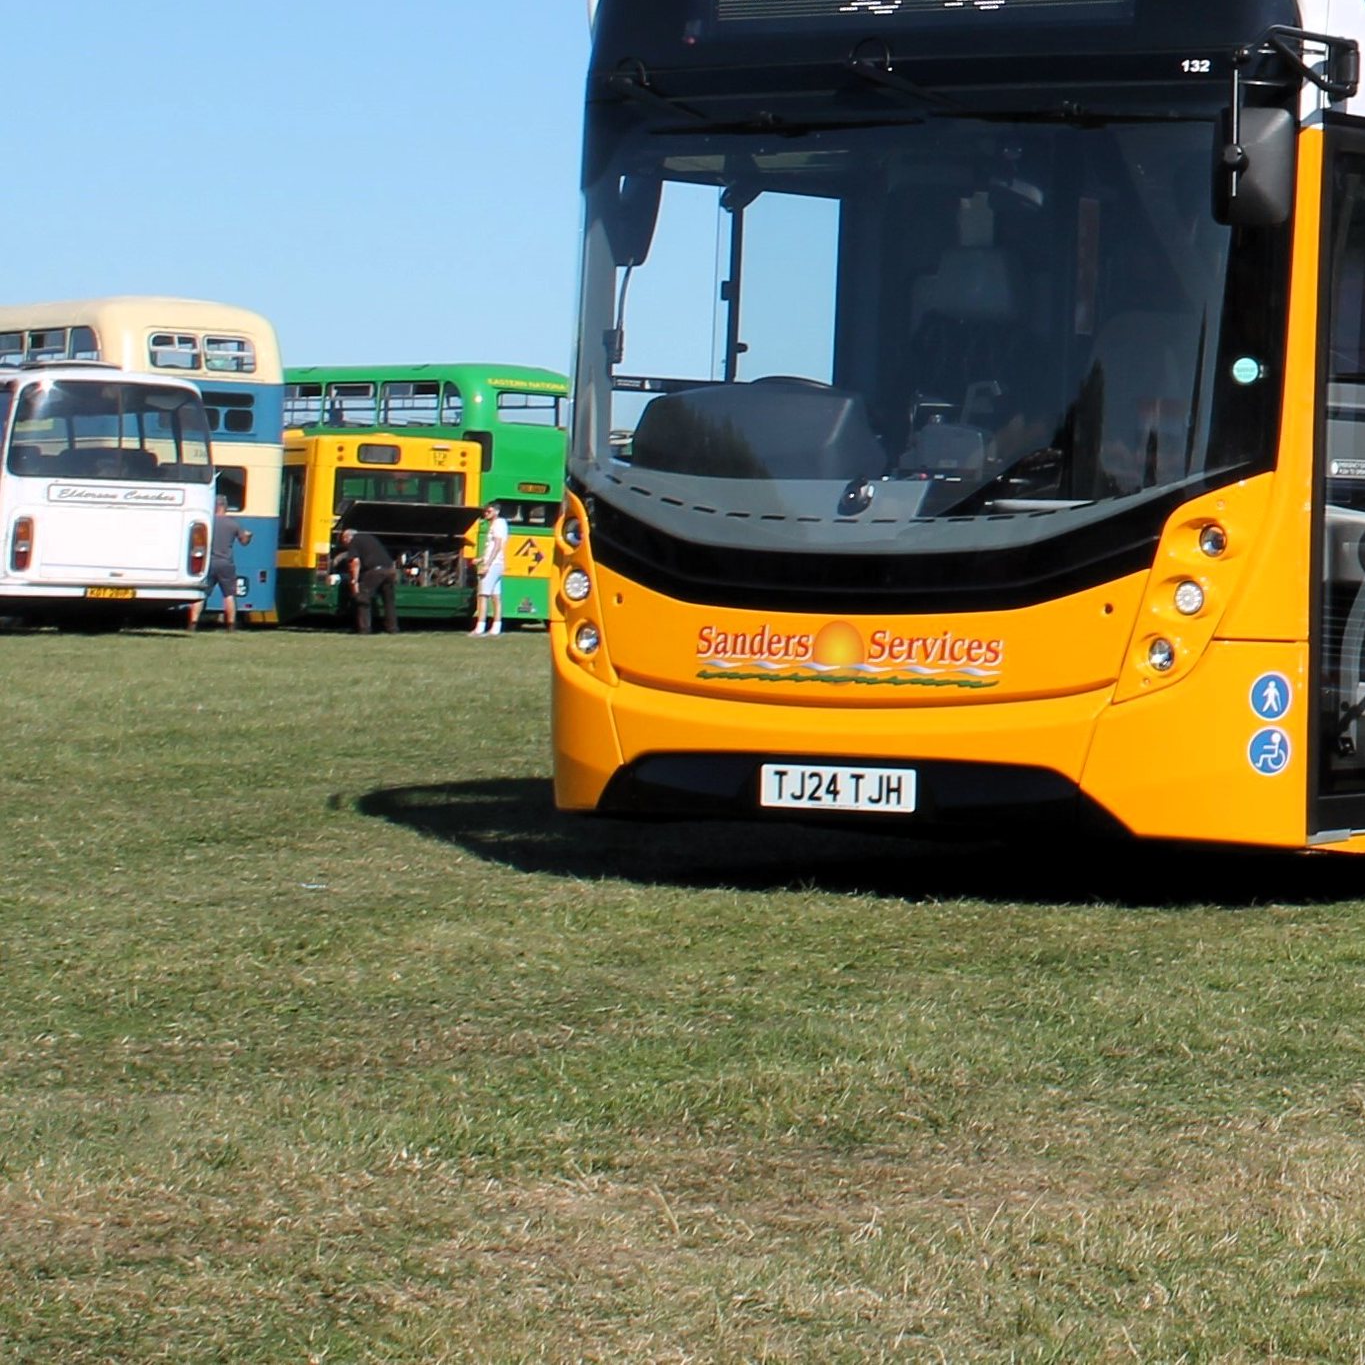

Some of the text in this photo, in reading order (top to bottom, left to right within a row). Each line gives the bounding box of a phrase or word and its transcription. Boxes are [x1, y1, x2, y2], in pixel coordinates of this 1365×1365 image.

[1181, 59, 1211, 73] 132
[696, 624, 1003, 666] Sanders Services
[773, 770, 903, 805] TJ24 TJH
